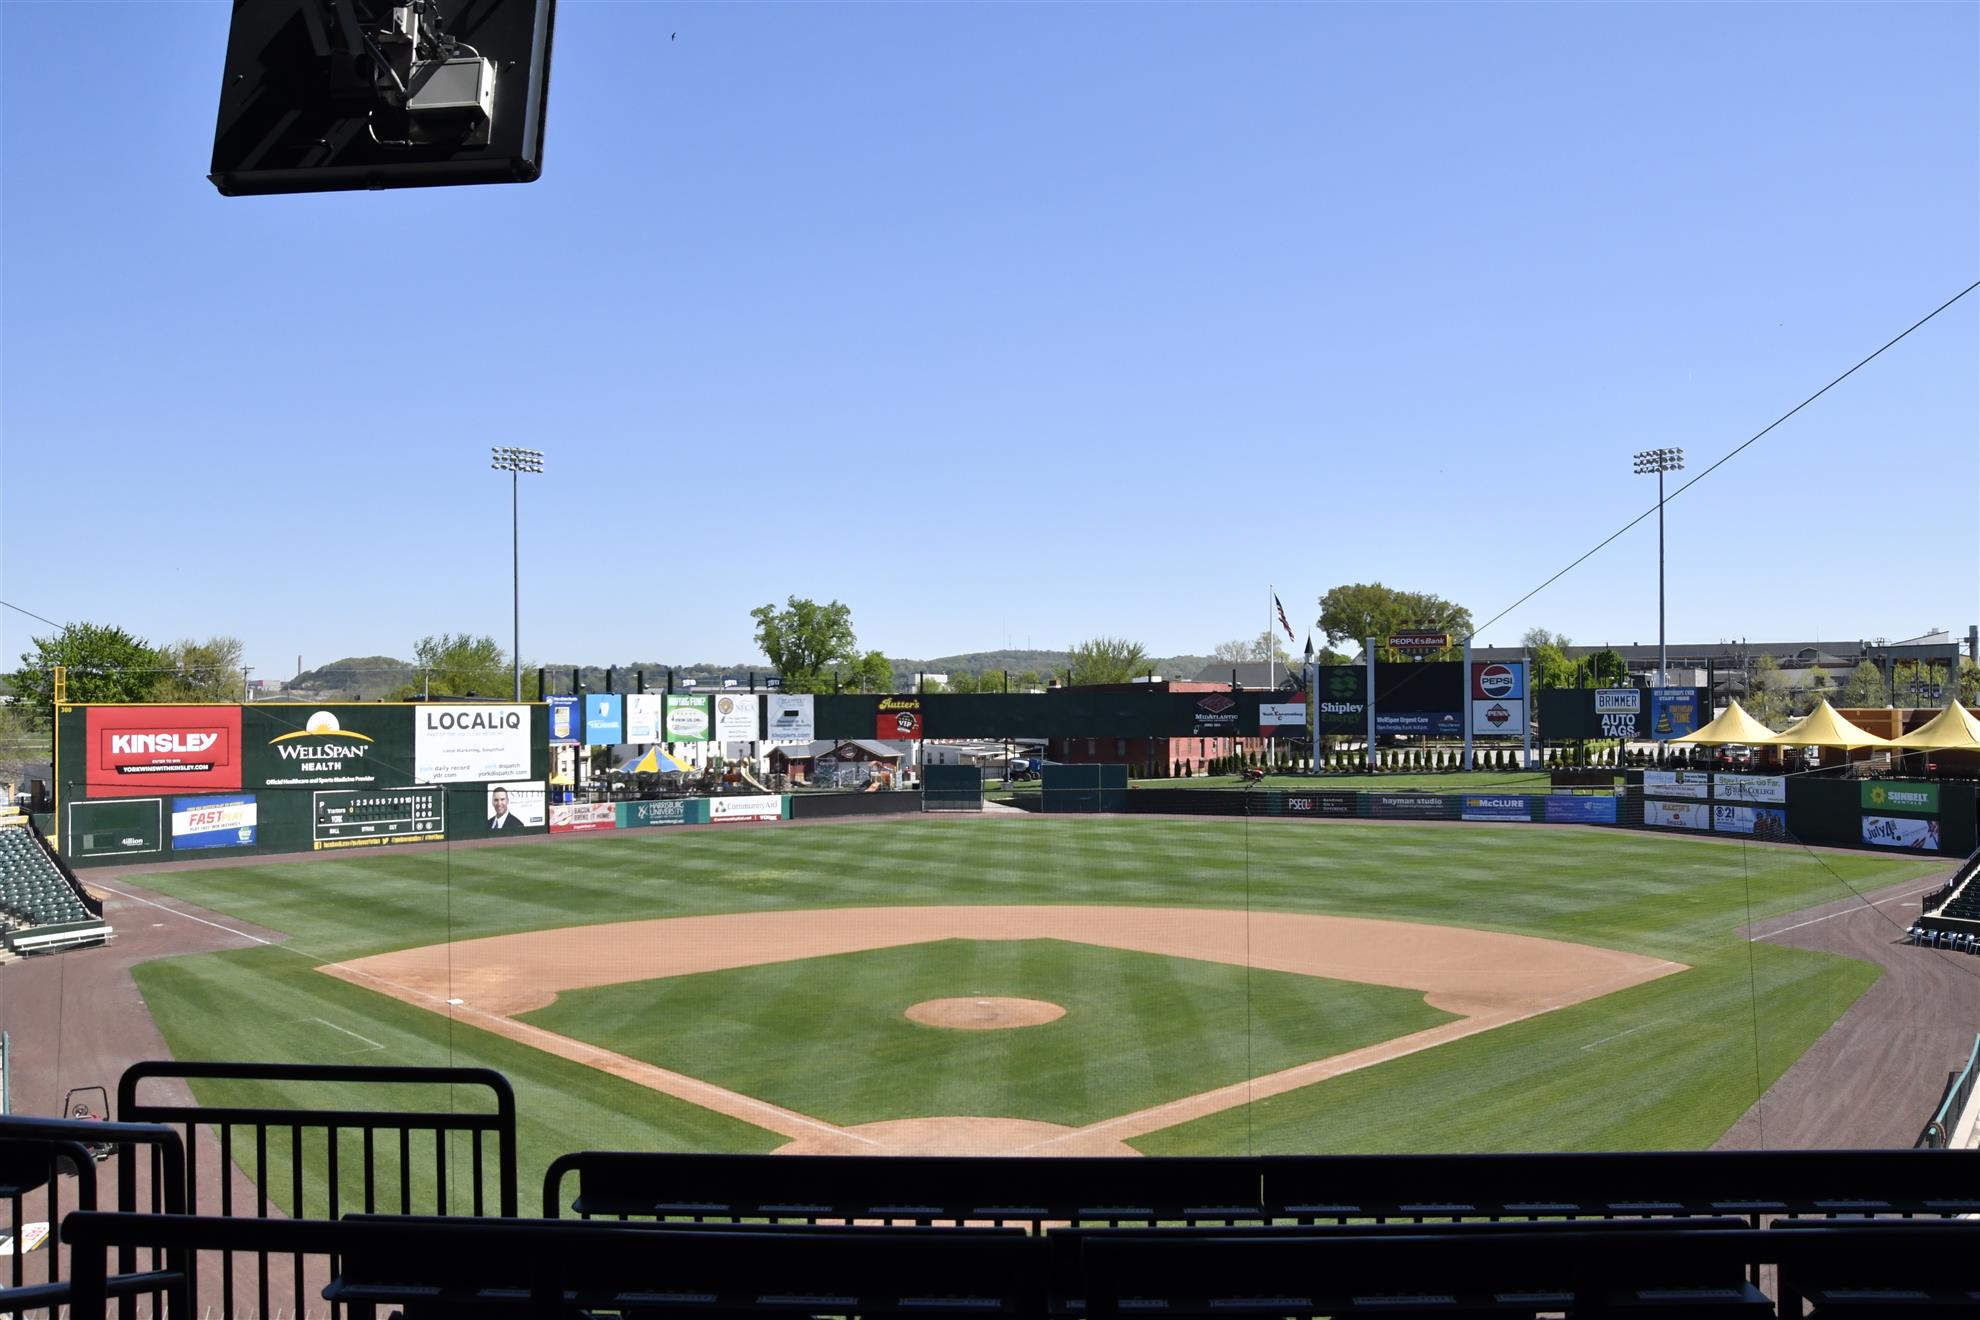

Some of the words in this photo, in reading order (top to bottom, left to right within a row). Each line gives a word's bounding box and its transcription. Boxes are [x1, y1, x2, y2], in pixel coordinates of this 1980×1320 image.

[1482, 677, 1513, 685] PEPSI
[879, 698, 920, 710] Rutter's
[1600, 696, 1636, 707] BRIMMER
[1321, 702, 1363, 714] Shipley
[1602, 715, 1635, 725] AUTO
[1602, 726, 1635, 737] TAGS
[112, 733, 218, 754] KINSLEY
[301, 762, 341, 771] HEALTH
[1888, 792, 1928, 802] SUNBELT
[728, 800, 778, 810] CommunityAid
[1725, 806, 1734, 818] 21
[189, 811, 224, 826] FAST
